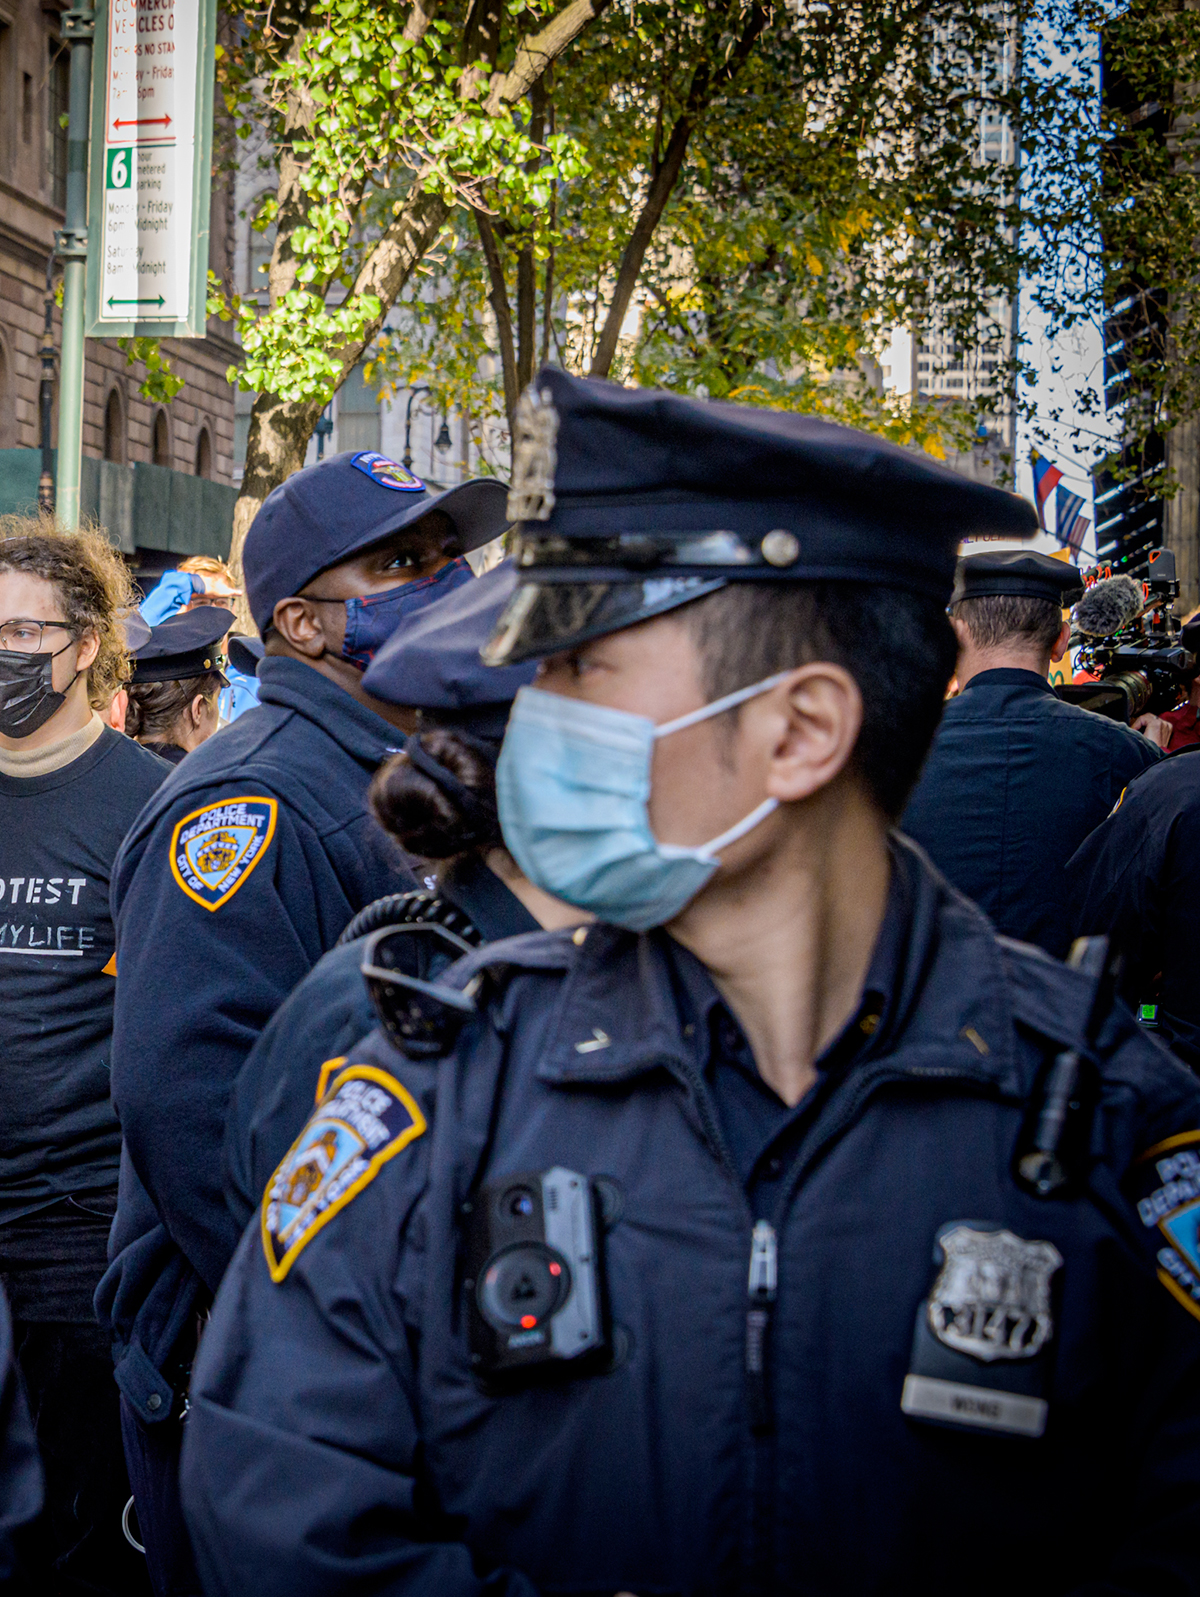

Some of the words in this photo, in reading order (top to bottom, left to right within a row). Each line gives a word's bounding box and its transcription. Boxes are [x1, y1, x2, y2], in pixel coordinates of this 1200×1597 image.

[144, 42, 155, 56] NO
[111, 150, 128, 188] 6
[147, 201, 173, 216] Friday
[107, 246, 144, 260] Satuay
[199, 803, 248, 825] POLICE
[179, 813, 266, 845] DEPARTMENT
[217, 866, 243, 893] NEW
[239, 835, 265, 865] YORK
